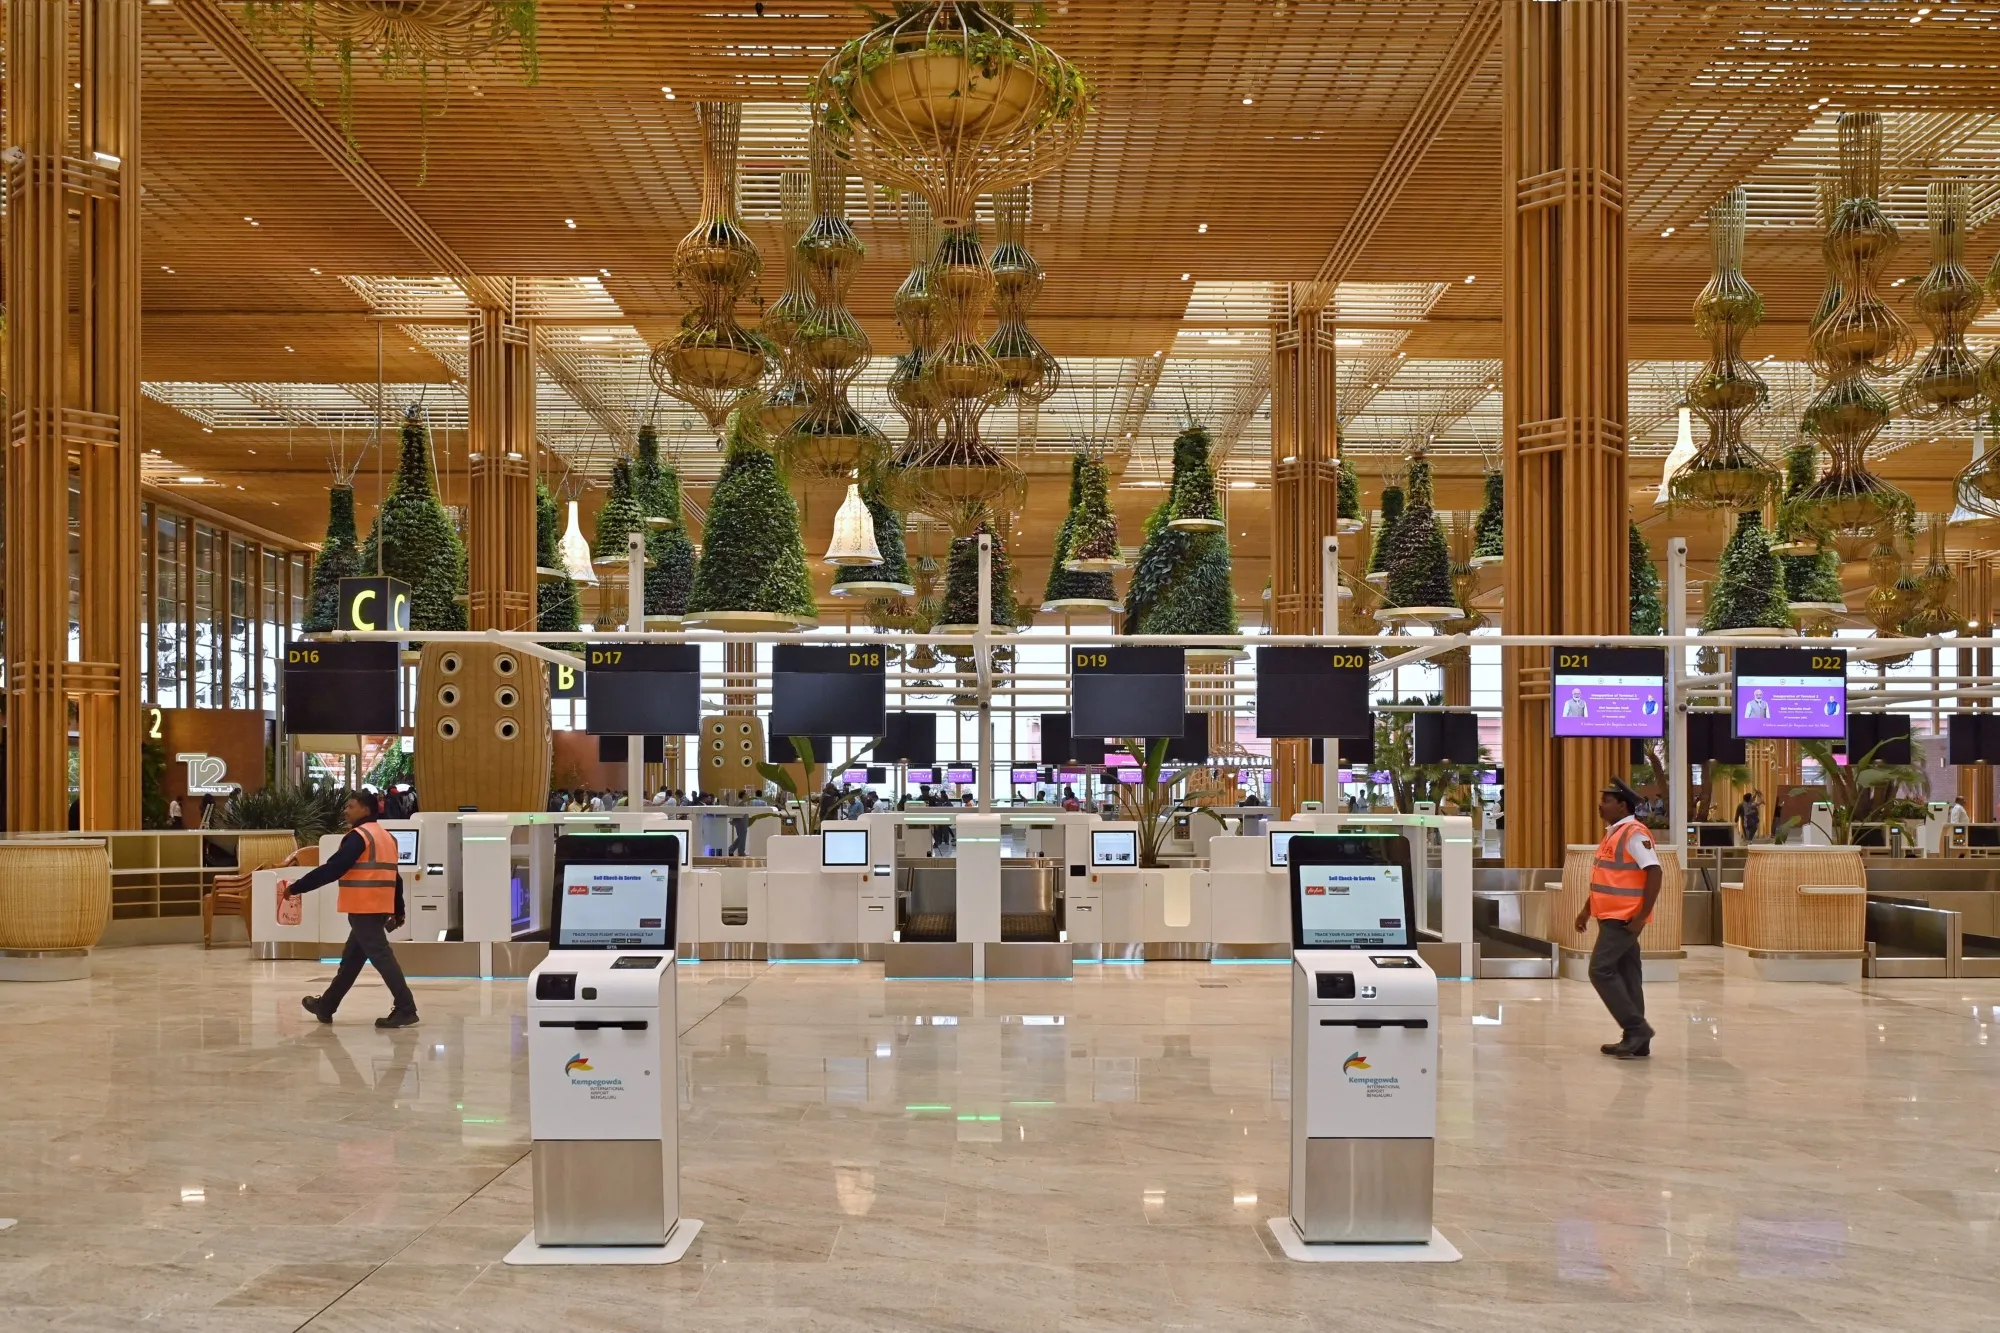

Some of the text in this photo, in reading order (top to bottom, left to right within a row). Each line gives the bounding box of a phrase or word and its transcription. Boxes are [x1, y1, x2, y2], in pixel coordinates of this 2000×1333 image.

[352, 590, 376, 632] C
[394, 594, 405, 632] C
[289, 651, 320, 663] D16
[592, 652, 623, 665] D17
[848, 653, 880, 667] D18
[1076, 654, 1108, 667] D19
[1333, 655, 1364, 669] D20
[1560, 655, 1588, 668] D21
[1812, 656, 1841, 669] D22
[558, 664, 575, 690] B
[150, 708, 162, 738] 2
[1227, 758, 1248, 766] TEA
[177, 754, 226, 787] T2
